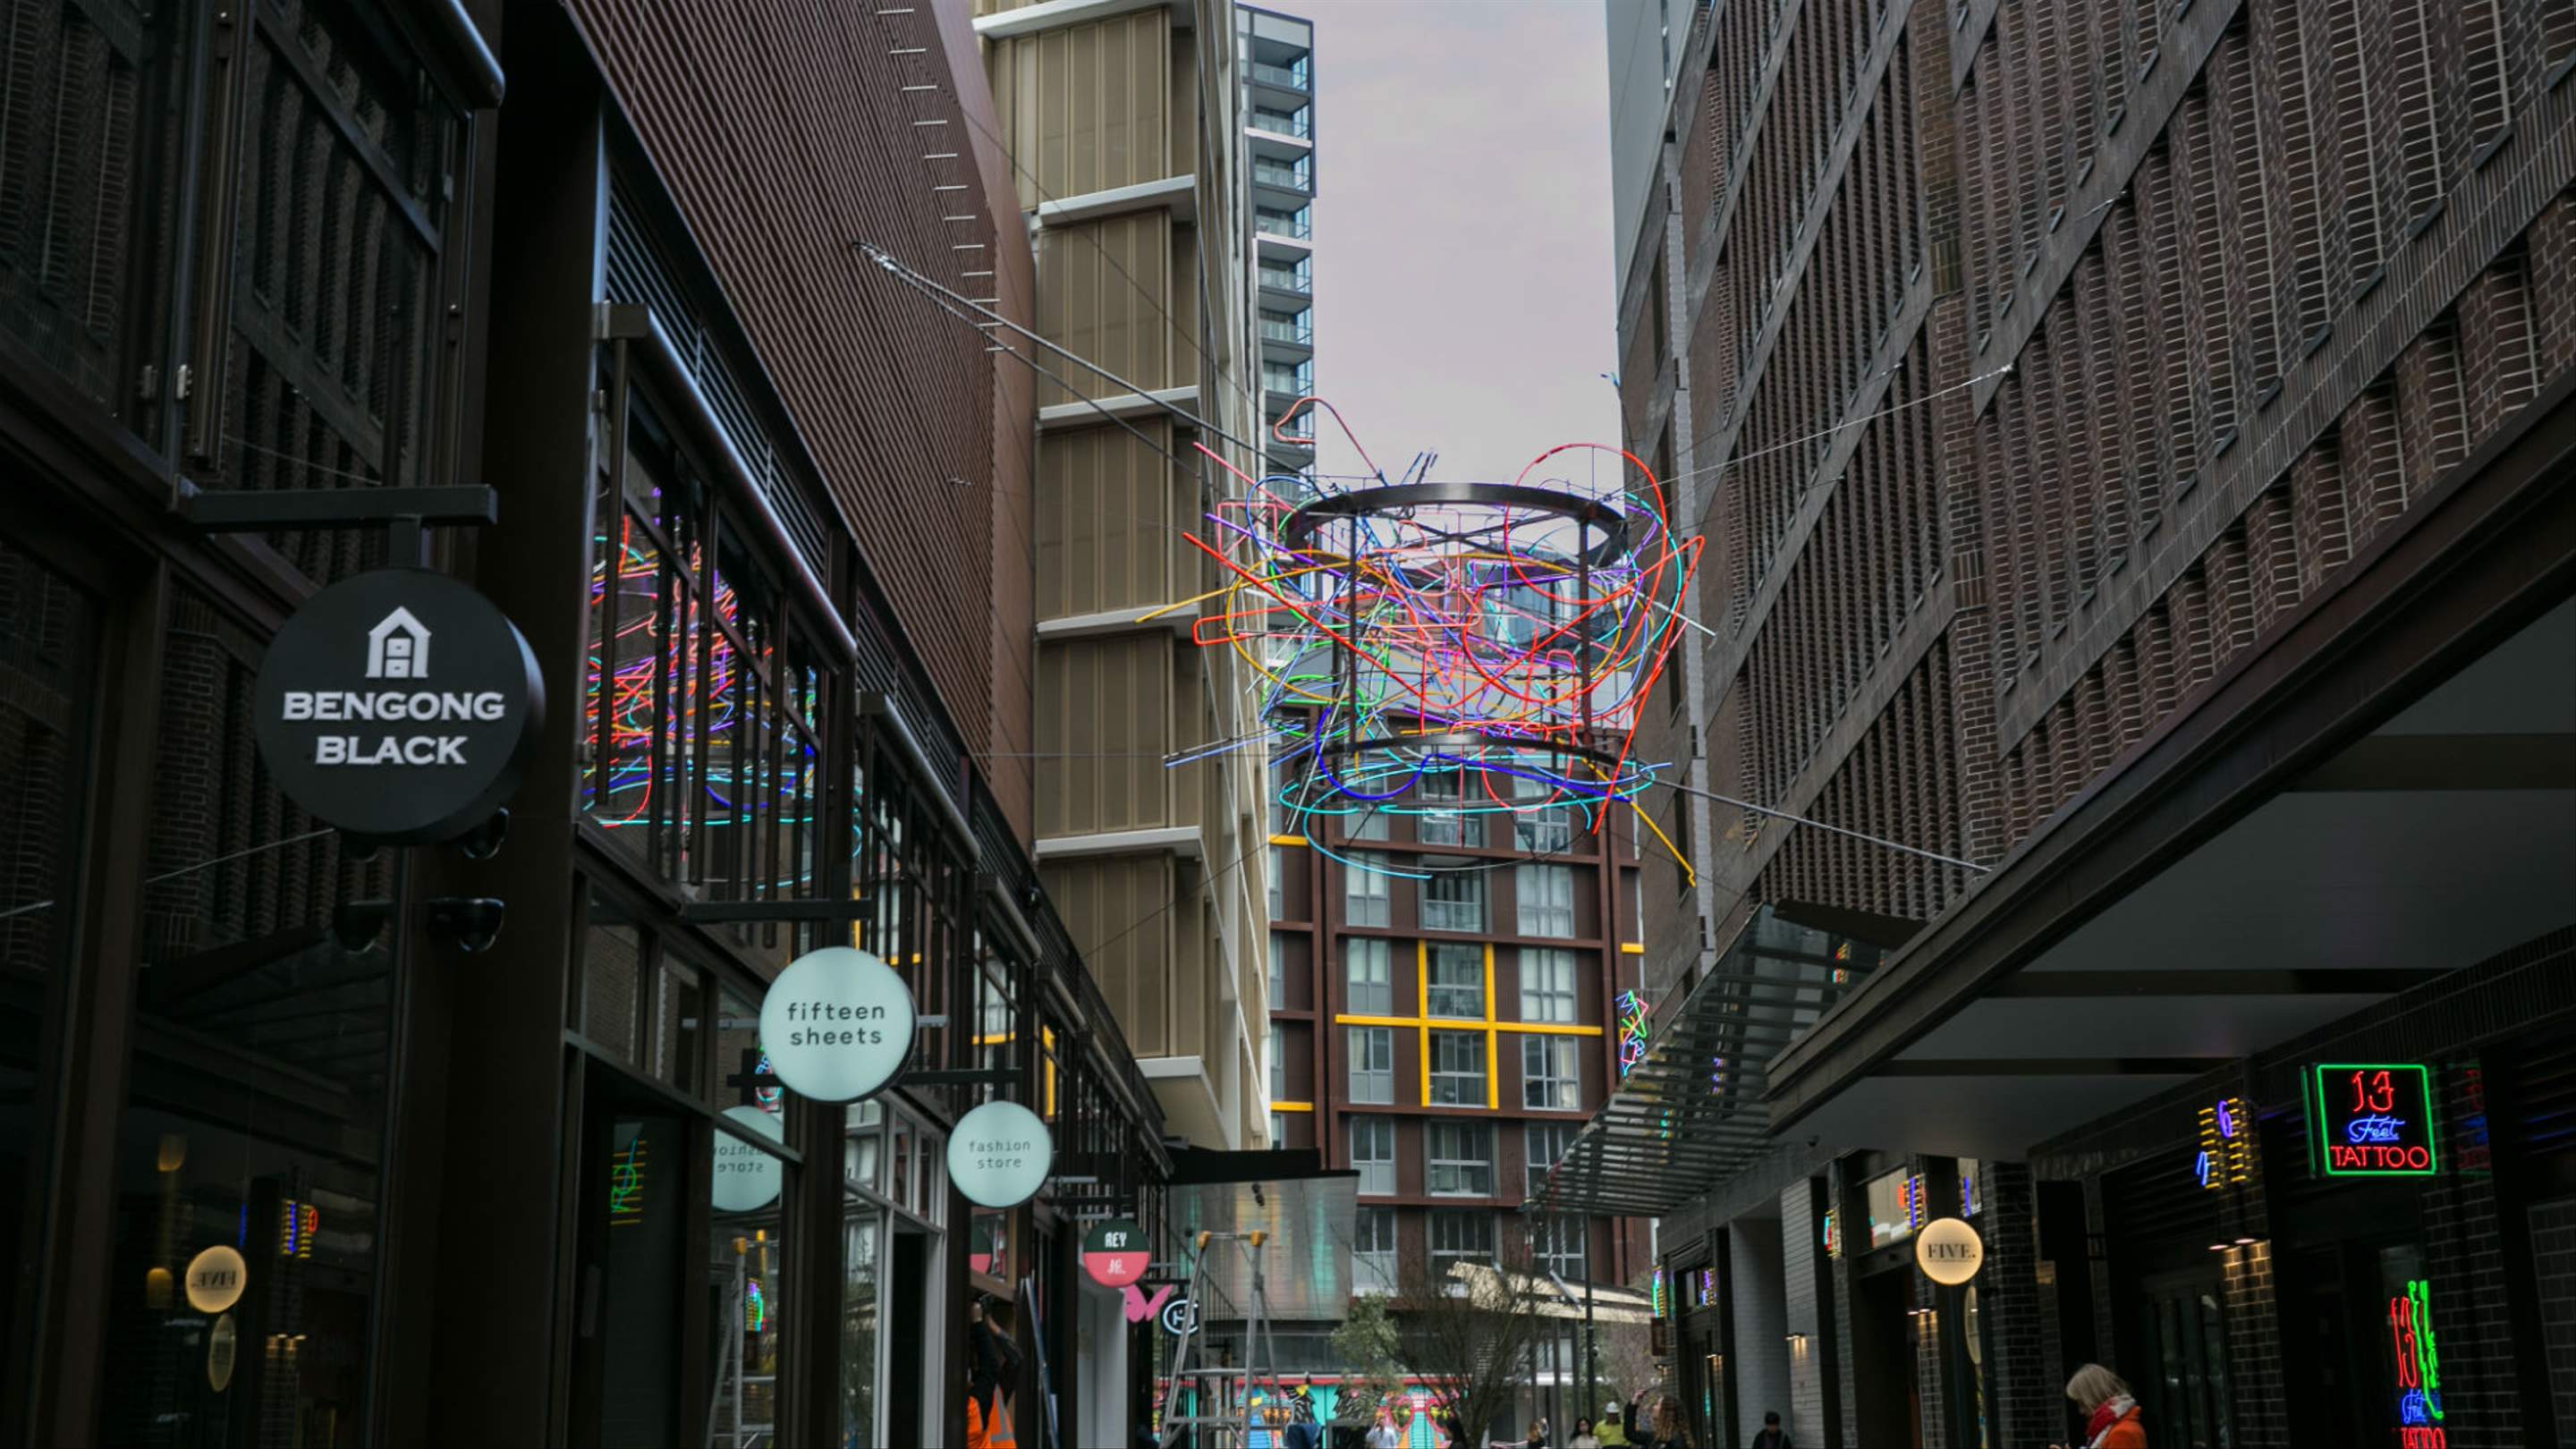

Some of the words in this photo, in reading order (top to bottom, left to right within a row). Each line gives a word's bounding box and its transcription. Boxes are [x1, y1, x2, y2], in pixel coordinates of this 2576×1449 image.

[282, 691, 505, 721] BENGONG
[316, 735, 468, 765] BLACK
[787, 1002, 886, 1020] fifteen
[790, 1027, 883, 1046] sheets
[2351, 1071, 2394, 1114] 13
[2348, 1114, 2406, 1143] Feet
[969, 1140, 1031, 1153] fashion
[977, 1157, 1022, 1169] store
[2329, 1146, 2430, 1168] TATTOO
[1104, 1232, 1127, 1248] REY
